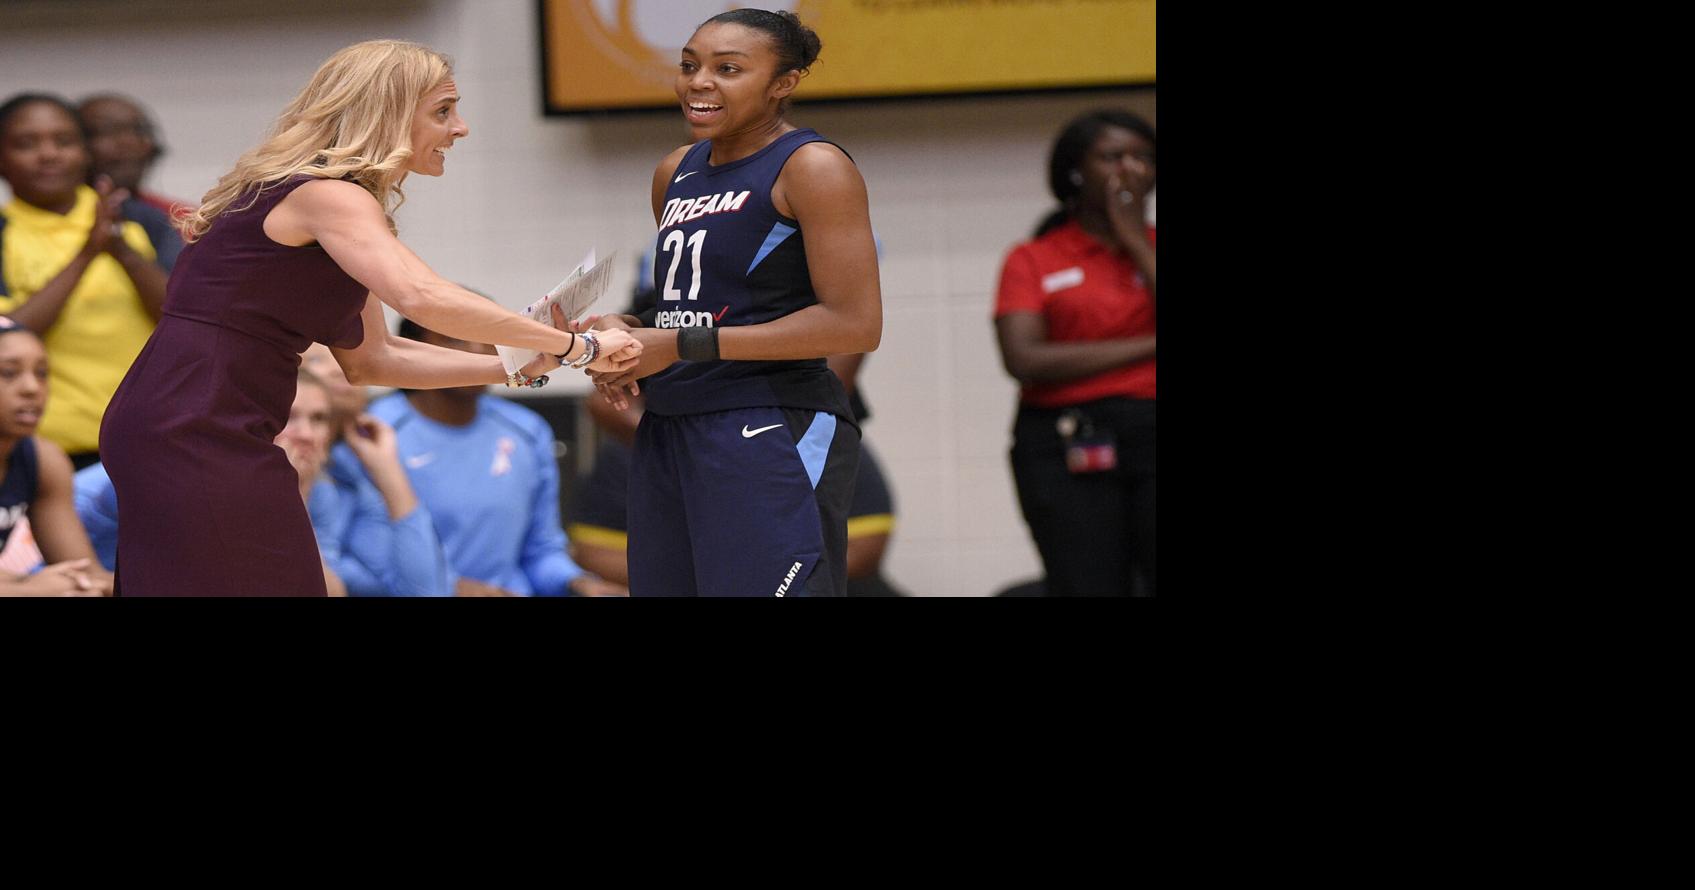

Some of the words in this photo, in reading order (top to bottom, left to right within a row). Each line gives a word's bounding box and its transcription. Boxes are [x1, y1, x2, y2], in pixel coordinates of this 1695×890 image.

[659, 190, 751, 232] DREAM
[662, 229, 707, 300] 21
[655, 306, 714, 328] verizon
[775, 561, 803, 597] ATLANTA
